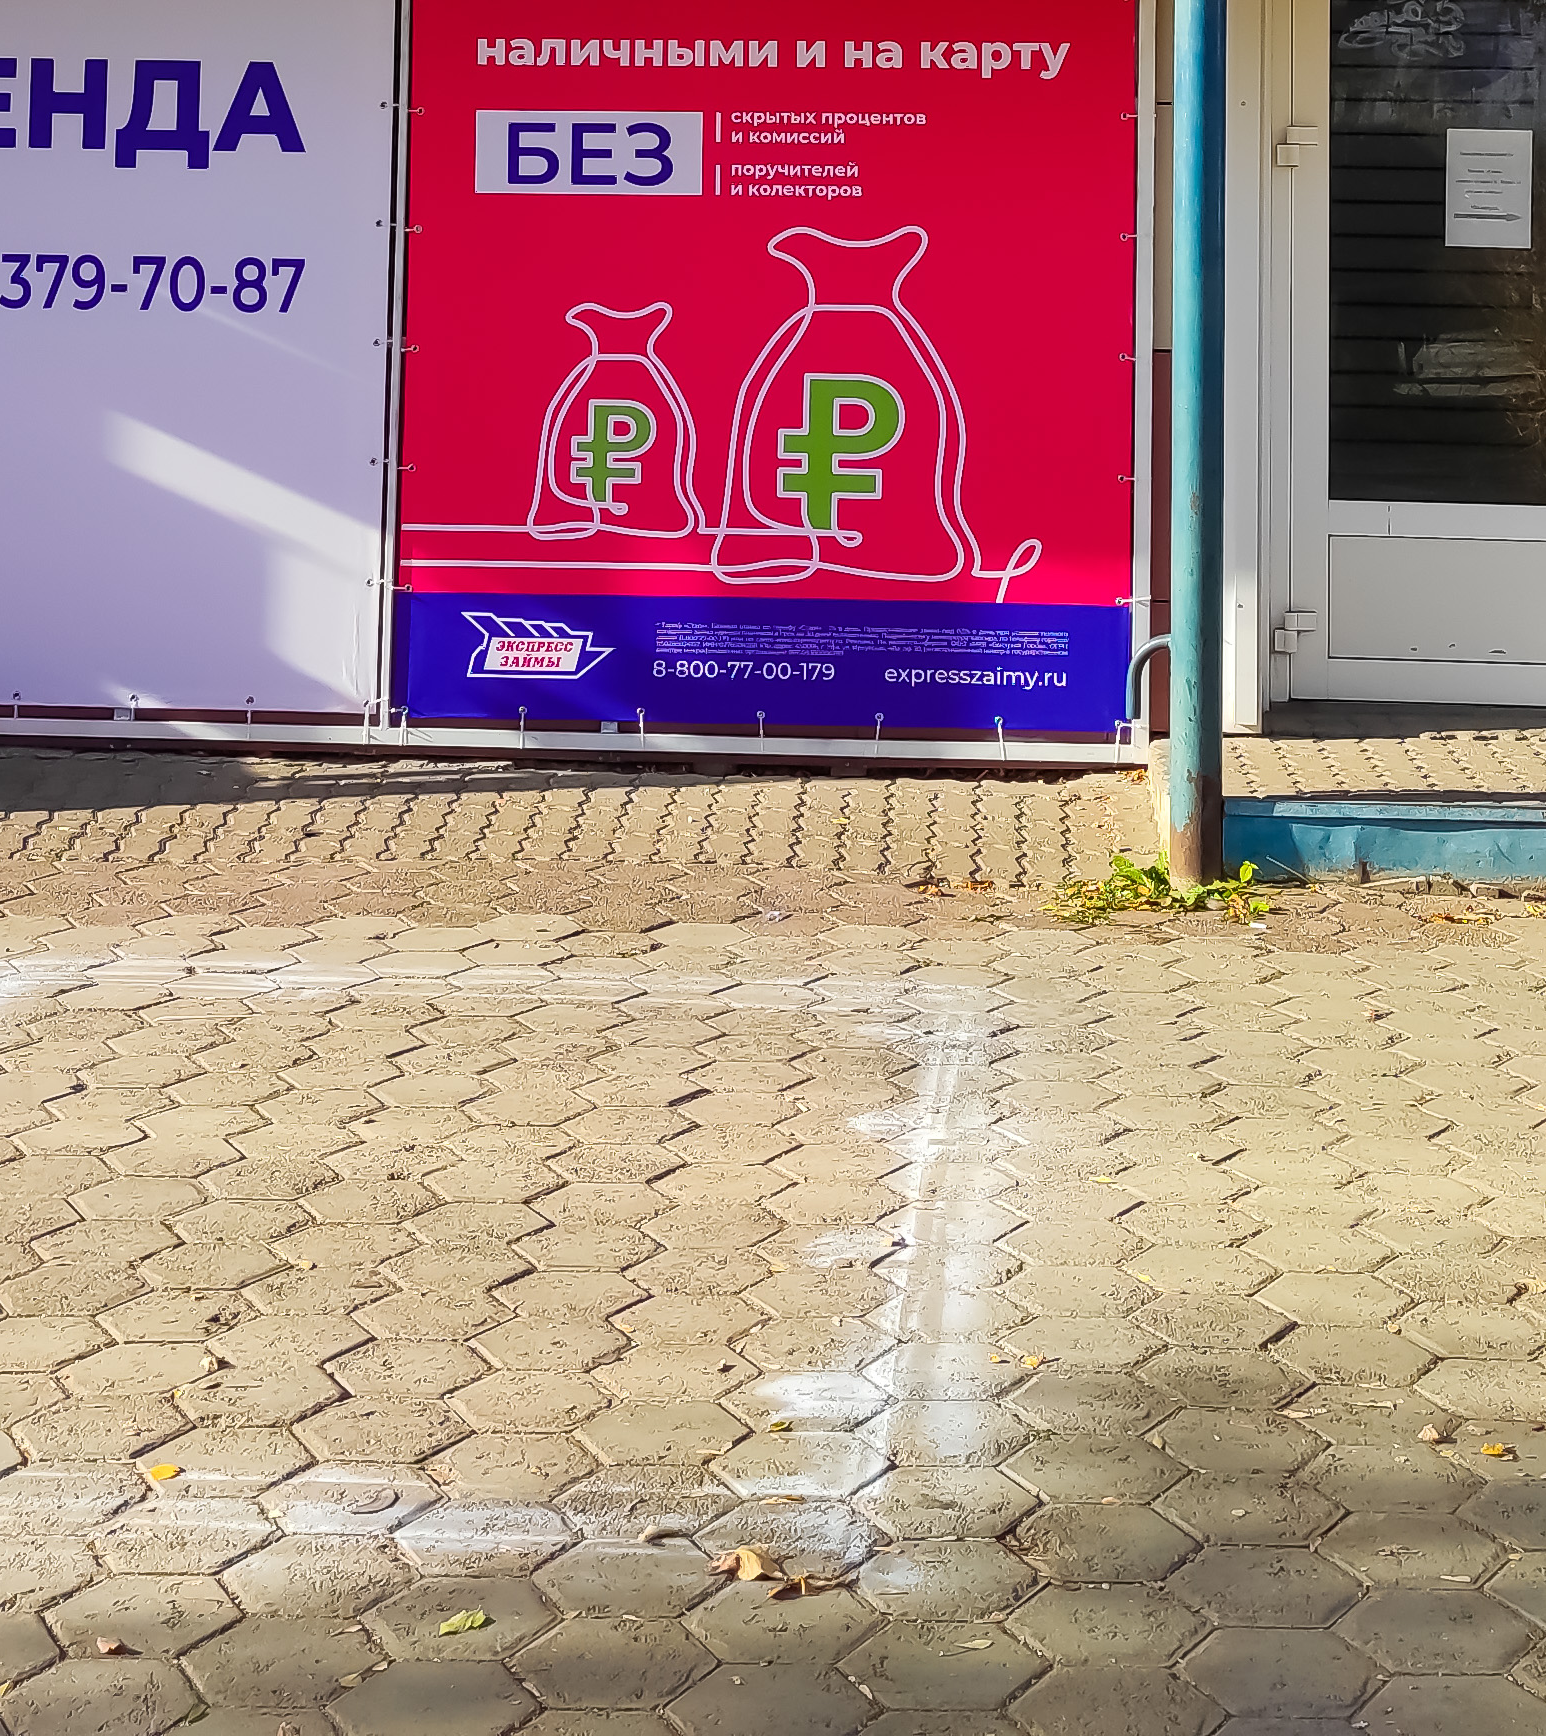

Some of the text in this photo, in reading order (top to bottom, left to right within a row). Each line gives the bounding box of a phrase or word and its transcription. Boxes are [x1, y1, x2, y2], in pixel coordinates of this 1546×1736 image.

[476, 37, 1071, 78] наличными и на карту
[731, 111, 927, 128] скрытых процентов
[731, 129, 845, 144] и комиссий
[506, 122, 674, 187] БЕЗ
[731, 162, 859, 179] поручителей
[730, 183, 862, 200] и колекторов
[495, 641, 574, 652] ЭКСПРЕСС
[499, 654, 562, 667] ЗАЙМЫ
[653, 660, 1067, 690] 8-800-77-00-179 expresszaimy.ru
